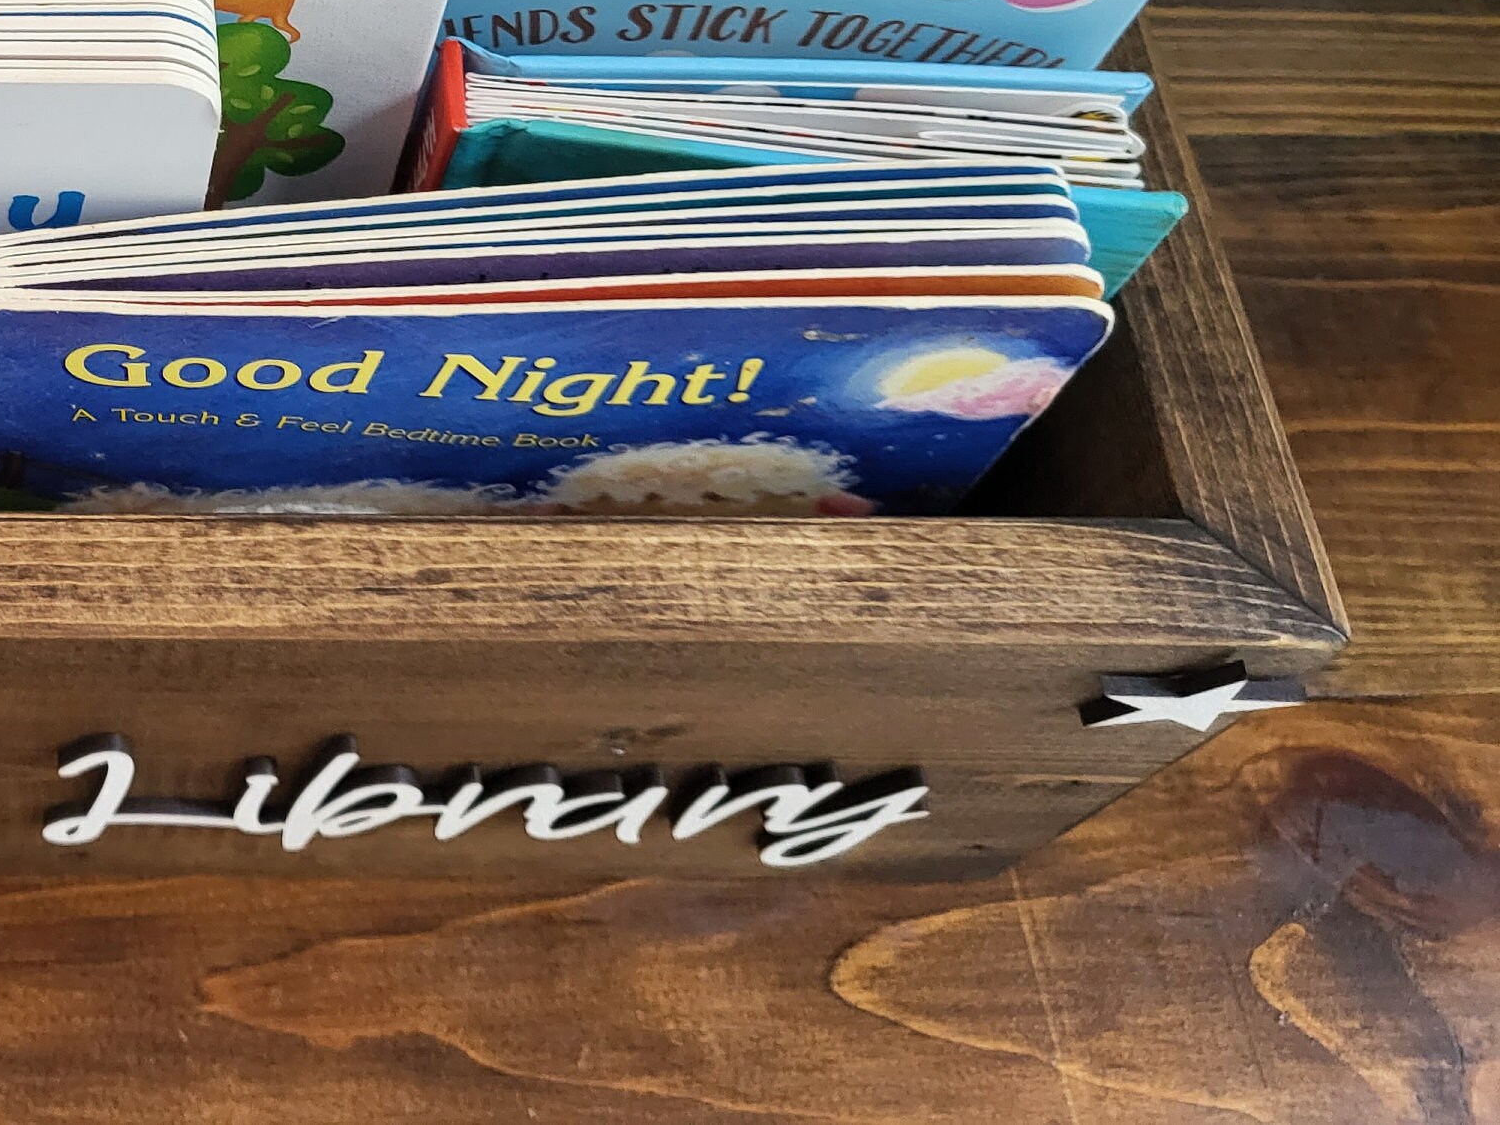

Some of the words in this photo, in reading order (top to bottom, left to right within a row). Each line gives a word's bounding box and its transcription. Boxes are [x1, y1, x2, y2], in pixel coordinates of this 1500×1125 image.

[616, 3, 789, 44] STICK
[63, 342, 386, 395] Good
[418, 353, 766, 417] Night!
[72, 408, 98, 423] A
[110, 407, 219, 426] Touch
[235, 413, 262, 428] &
[276, 416, 354, 435] Feel
[361, 421, 501, 448] Bedtime
[511, 432, 600, 449] Book
[41, 741, 933, 869] Library
